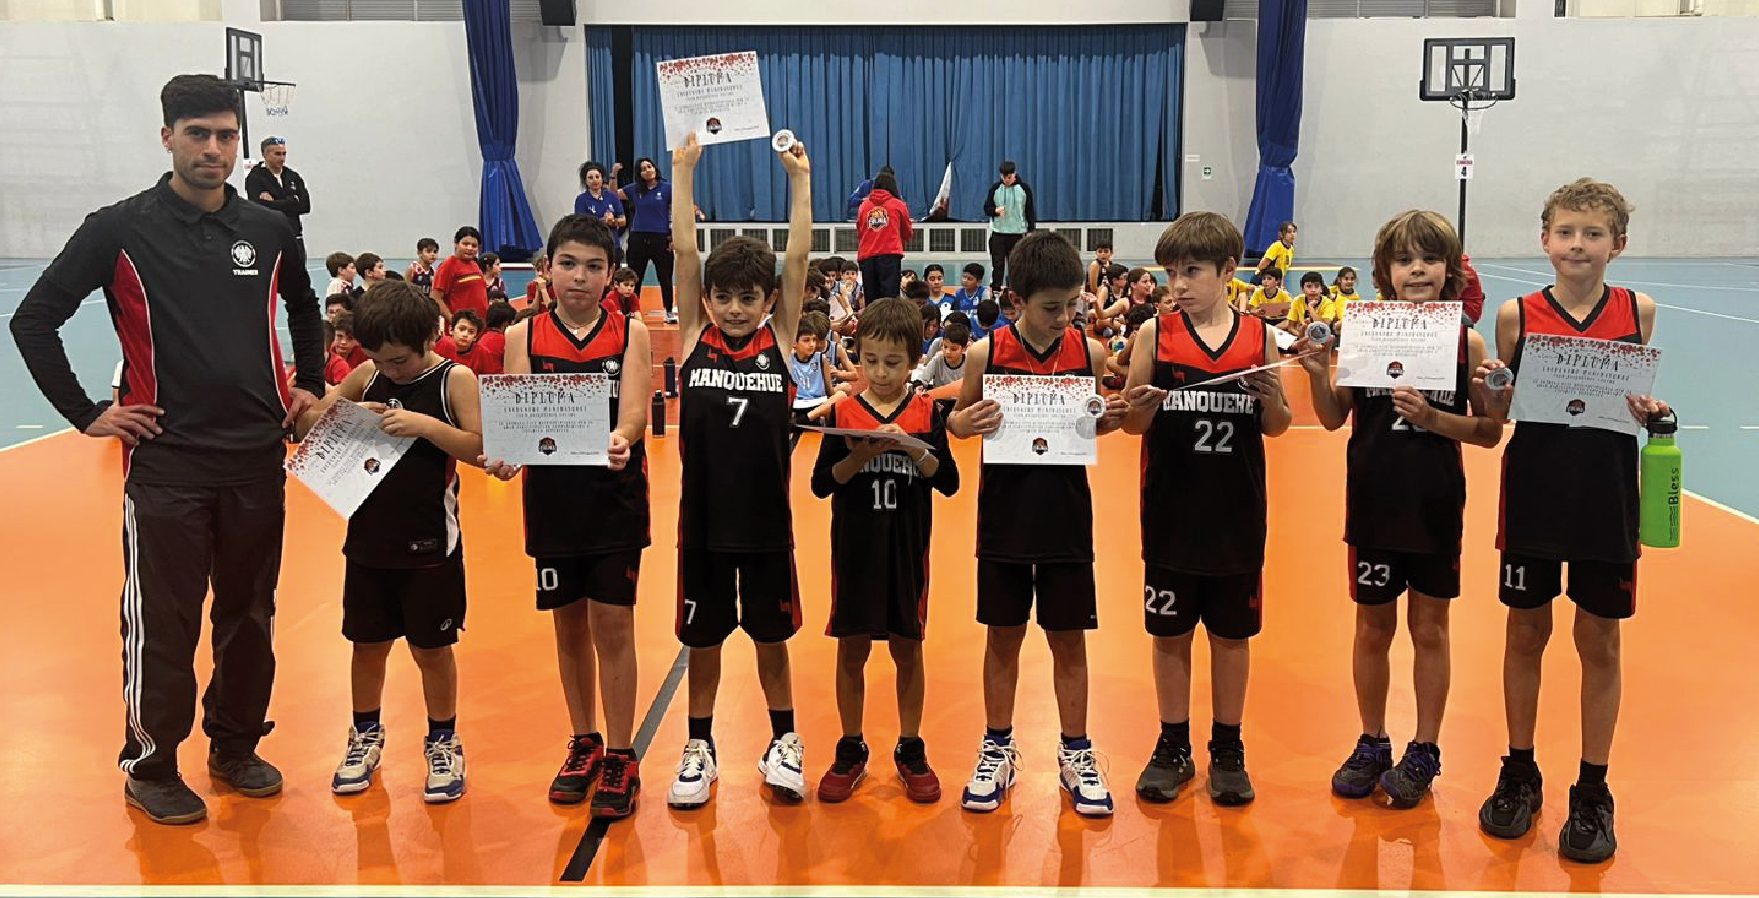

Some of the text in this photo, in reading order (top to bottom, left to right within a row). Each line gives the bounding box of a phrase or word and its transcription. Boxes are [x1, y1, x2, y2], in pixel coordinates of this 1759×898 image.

[688, 368, 784, 393] MANQUEHUE
[726, 396, 749, 428] 7
[1162, 390, 1256, 414] MANQUEHU
[1194, 421, 1234, 453] 22
[872, 479, 897, 510] 10
[1667, 467, 1680, 505] Bless
[1357, 562, 1391, 587] 23
[1504, 564, 1527, 591] 11
[685, 598, 697, 625] 7
[1144, 585, 1178, 616] 22
